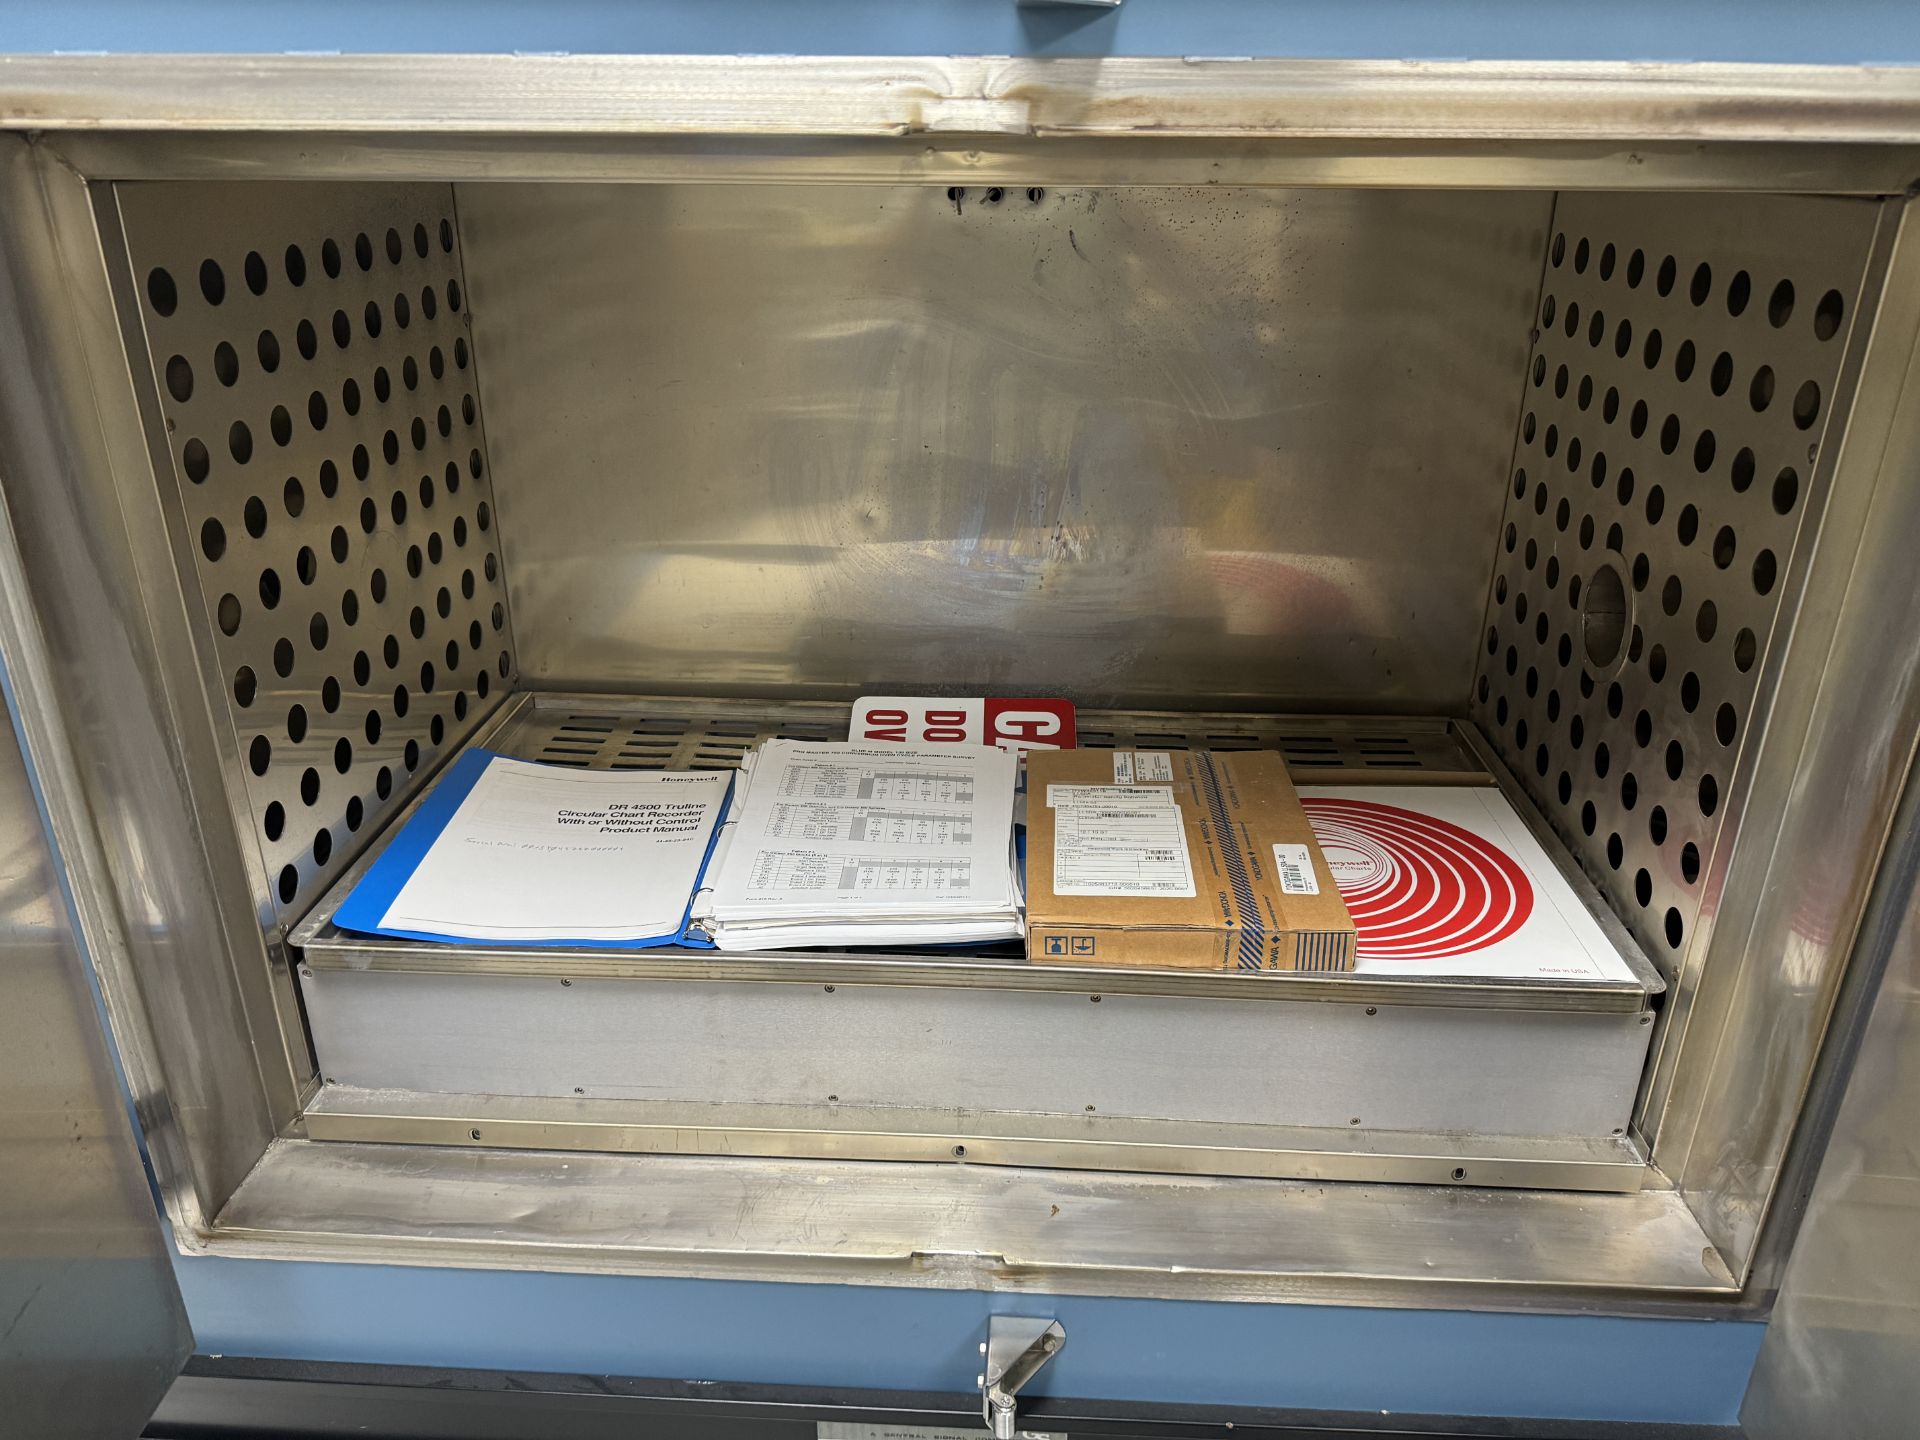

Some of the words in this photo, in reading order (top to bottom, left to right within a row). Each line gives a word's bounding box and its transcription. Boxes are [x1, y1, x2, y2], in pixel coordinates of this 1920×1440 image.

[665, 802, 706, 810] Truline
[558, 810, 608, 818] Circular
[648, 810, 705, 818] Recorder
[605, 818, 653, 826] Without
[656, 816, 702, 826] Control
[652, 824, 699, 834] Manual
[1218, 890, 1232, 918] YOKOGAWA
